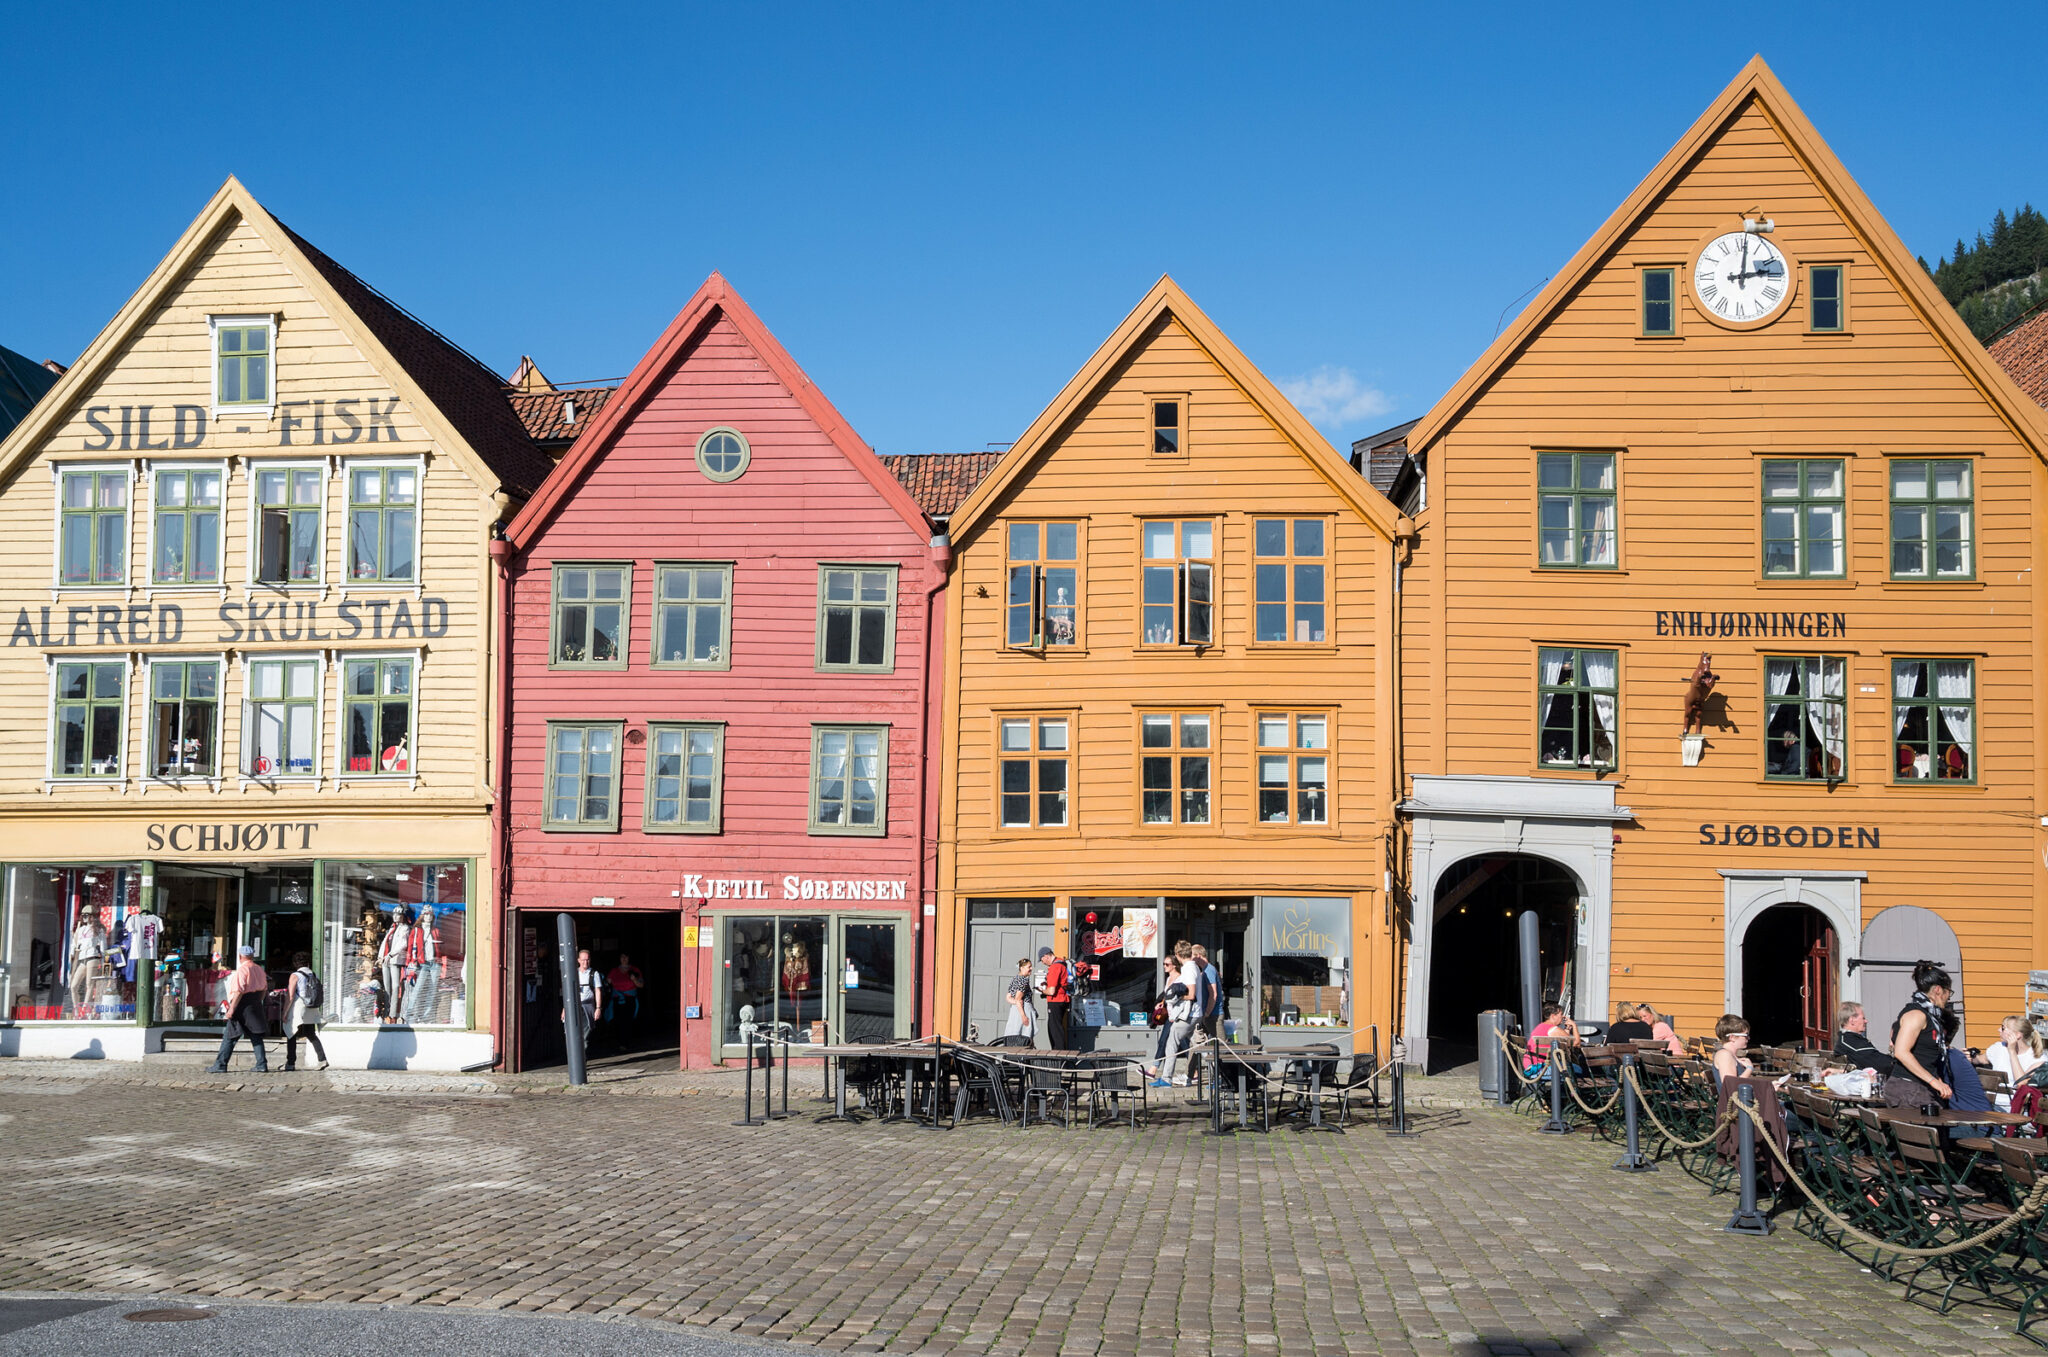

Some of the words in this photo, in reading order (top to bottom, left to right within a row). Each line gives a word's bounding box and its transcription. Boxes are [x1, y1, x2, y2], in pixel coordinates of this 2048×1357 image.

[84, 404, 207, 450] SILD
[279, 396, 401, 447] FISK
[7, 603, 184, 648] ALFRED
[217, 597, 449, 643] SKULSTAD
[1655, 611, 1847, 638] ENHJØRNINGEN
[146, 823, 319, 852] SCHJØTT
[1699, 824, 1880, 848] SJØBODEN
[783, 875, 907, 900] SØRENSEN
[11, 1005, 63, 1020] NORWAY
